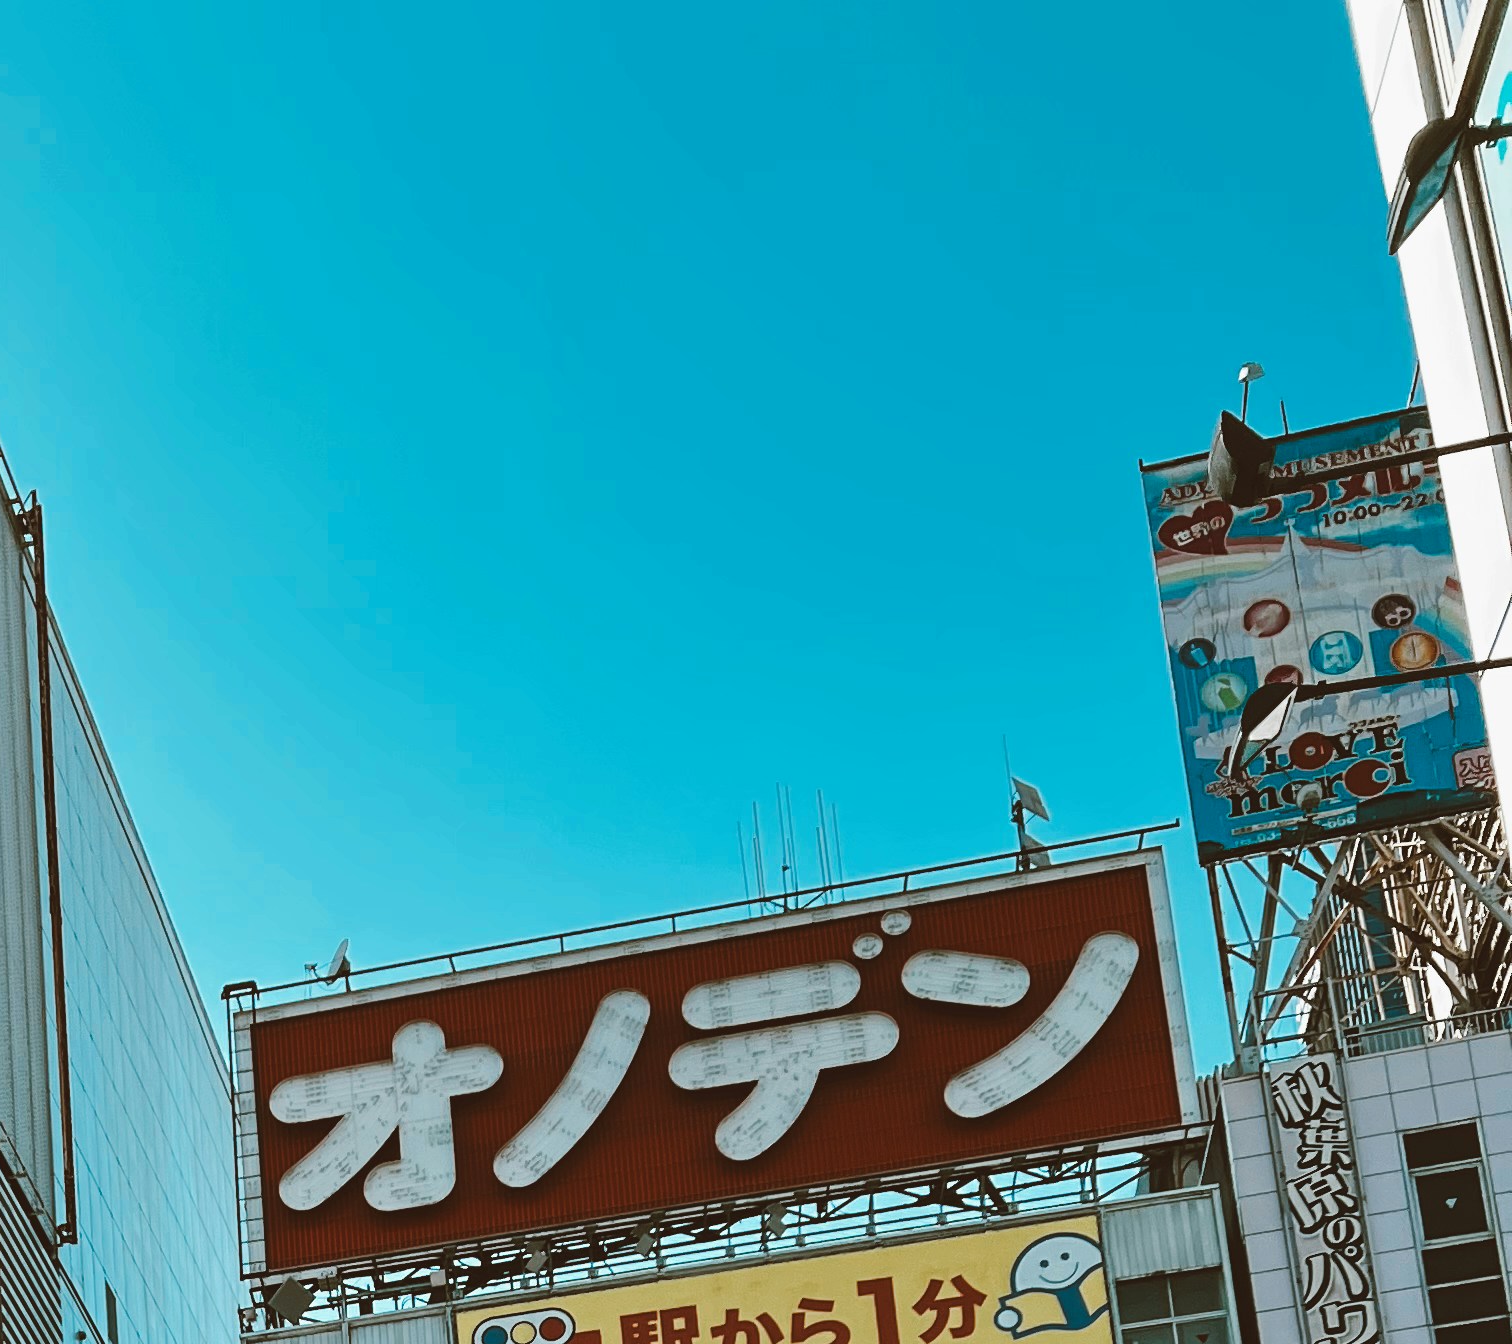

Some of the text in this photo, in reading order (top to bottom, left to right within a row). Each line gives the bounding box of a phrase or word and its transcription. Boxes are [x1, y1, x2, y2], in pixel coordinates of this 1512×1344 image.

[1269, 434, 1424, 478] MUSEMENT
[1172, 515, 1226, 548] 世界の
[269, 910, 1140, 1212] オノデン
